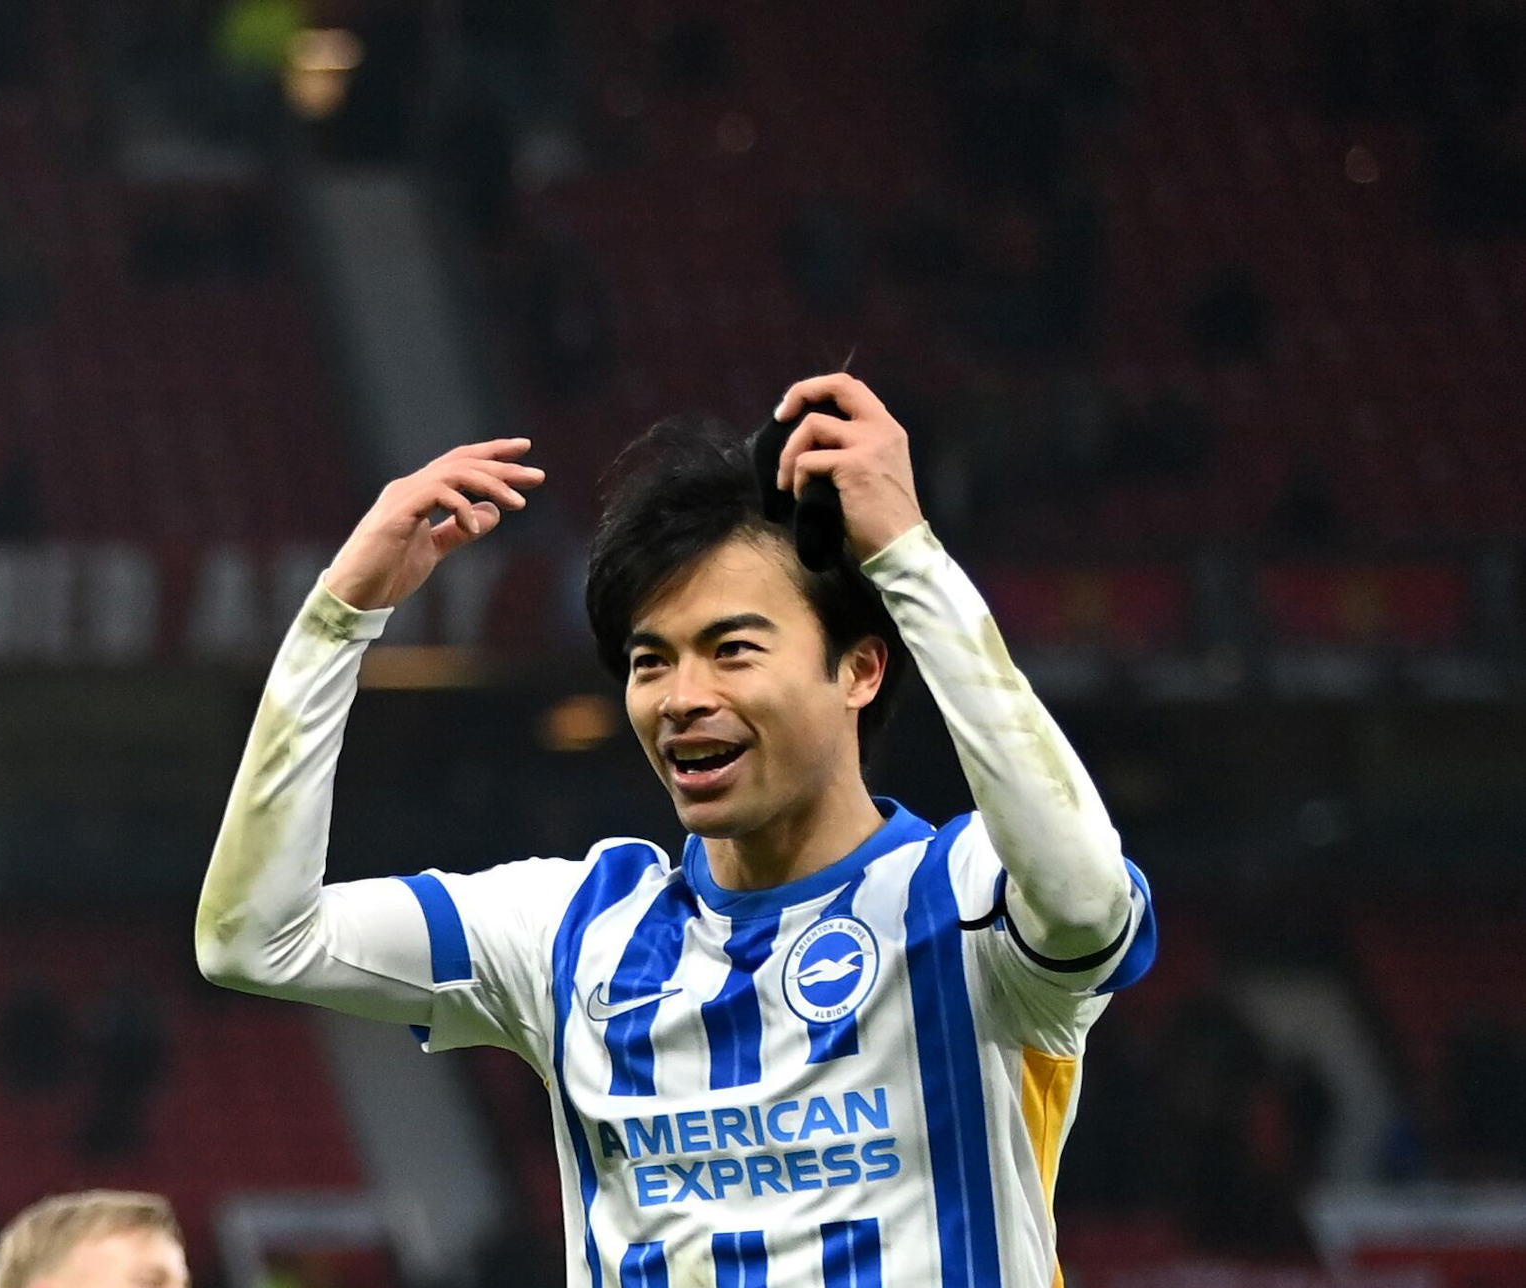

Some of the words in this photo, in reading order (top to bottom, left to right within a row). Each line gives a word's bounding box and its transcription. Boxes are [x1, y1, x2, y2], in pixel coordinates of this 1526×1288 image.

[814, 1004, 850, 1019] ALBION
[598, 1087, 890, 1160] AMERICAN
[634, 1137, 902, 1207] EXPRESS
